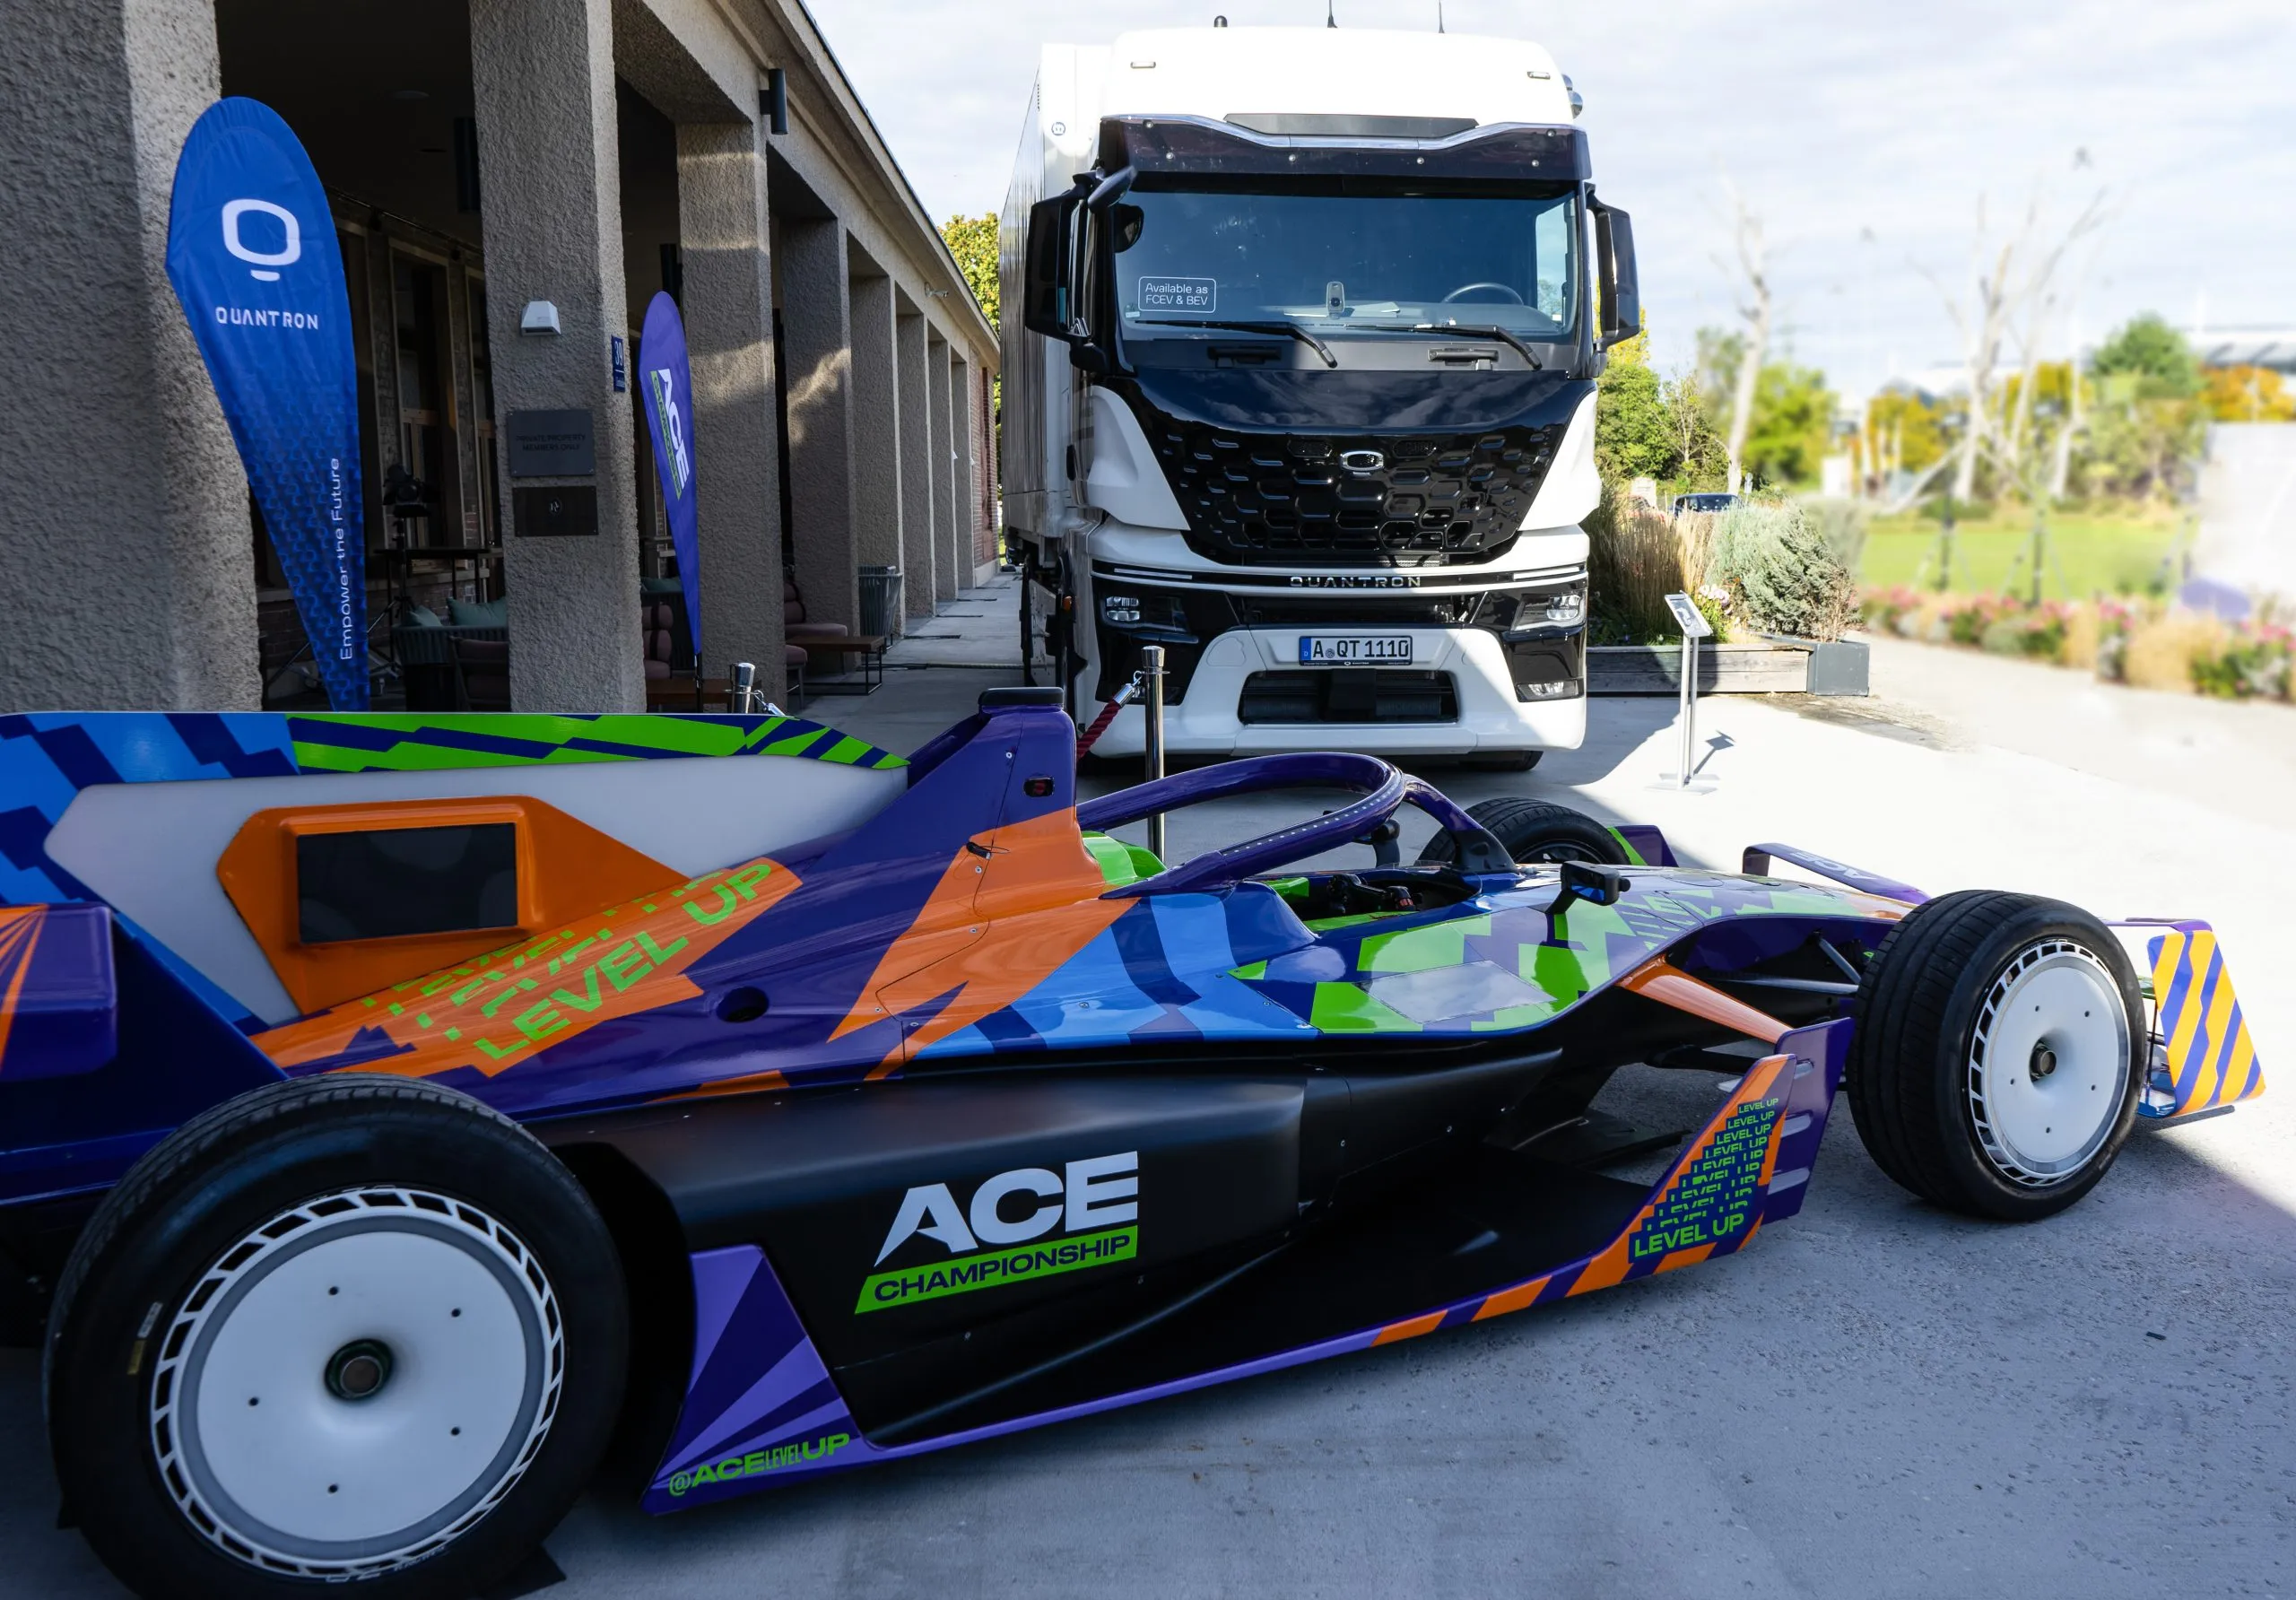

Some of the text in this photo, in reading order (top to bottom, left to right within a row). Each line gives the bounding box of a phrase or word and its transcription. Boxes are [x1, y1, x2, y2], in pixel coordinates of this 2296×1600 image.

[1144, 283, 1192, 293] Available
[1145, 295, 1208, 306] FCEV & BEV
[215, 307, 318, 330] QUANTRON
[614, 341, 623, 366] 39
[658, 369, 690, 491] ACE
[330, 457, 353, 660] Empower the Future
[1290, 576, 1421, 587] QUANTRON
[1313, 640, 1409, 658] A QT 1110
[474, 931, 690, 1060] LEVEL
[682, 863, 772, 926] UP
[1738, 1098, 1779, 1114] LEVEL UP
[1727, 1110, 1775, 1129] LEVEL UP
[1716, 1123, 1771, 1145] LEVEL UP
[874, 1151, 1138, 1268] ACE
[1635, 1224, 1707, 1257] LEVEL
[1712, 1213, 1744, 1236] UP
[874, 1234, 1130, 1301] CHAMPIONSHIP
